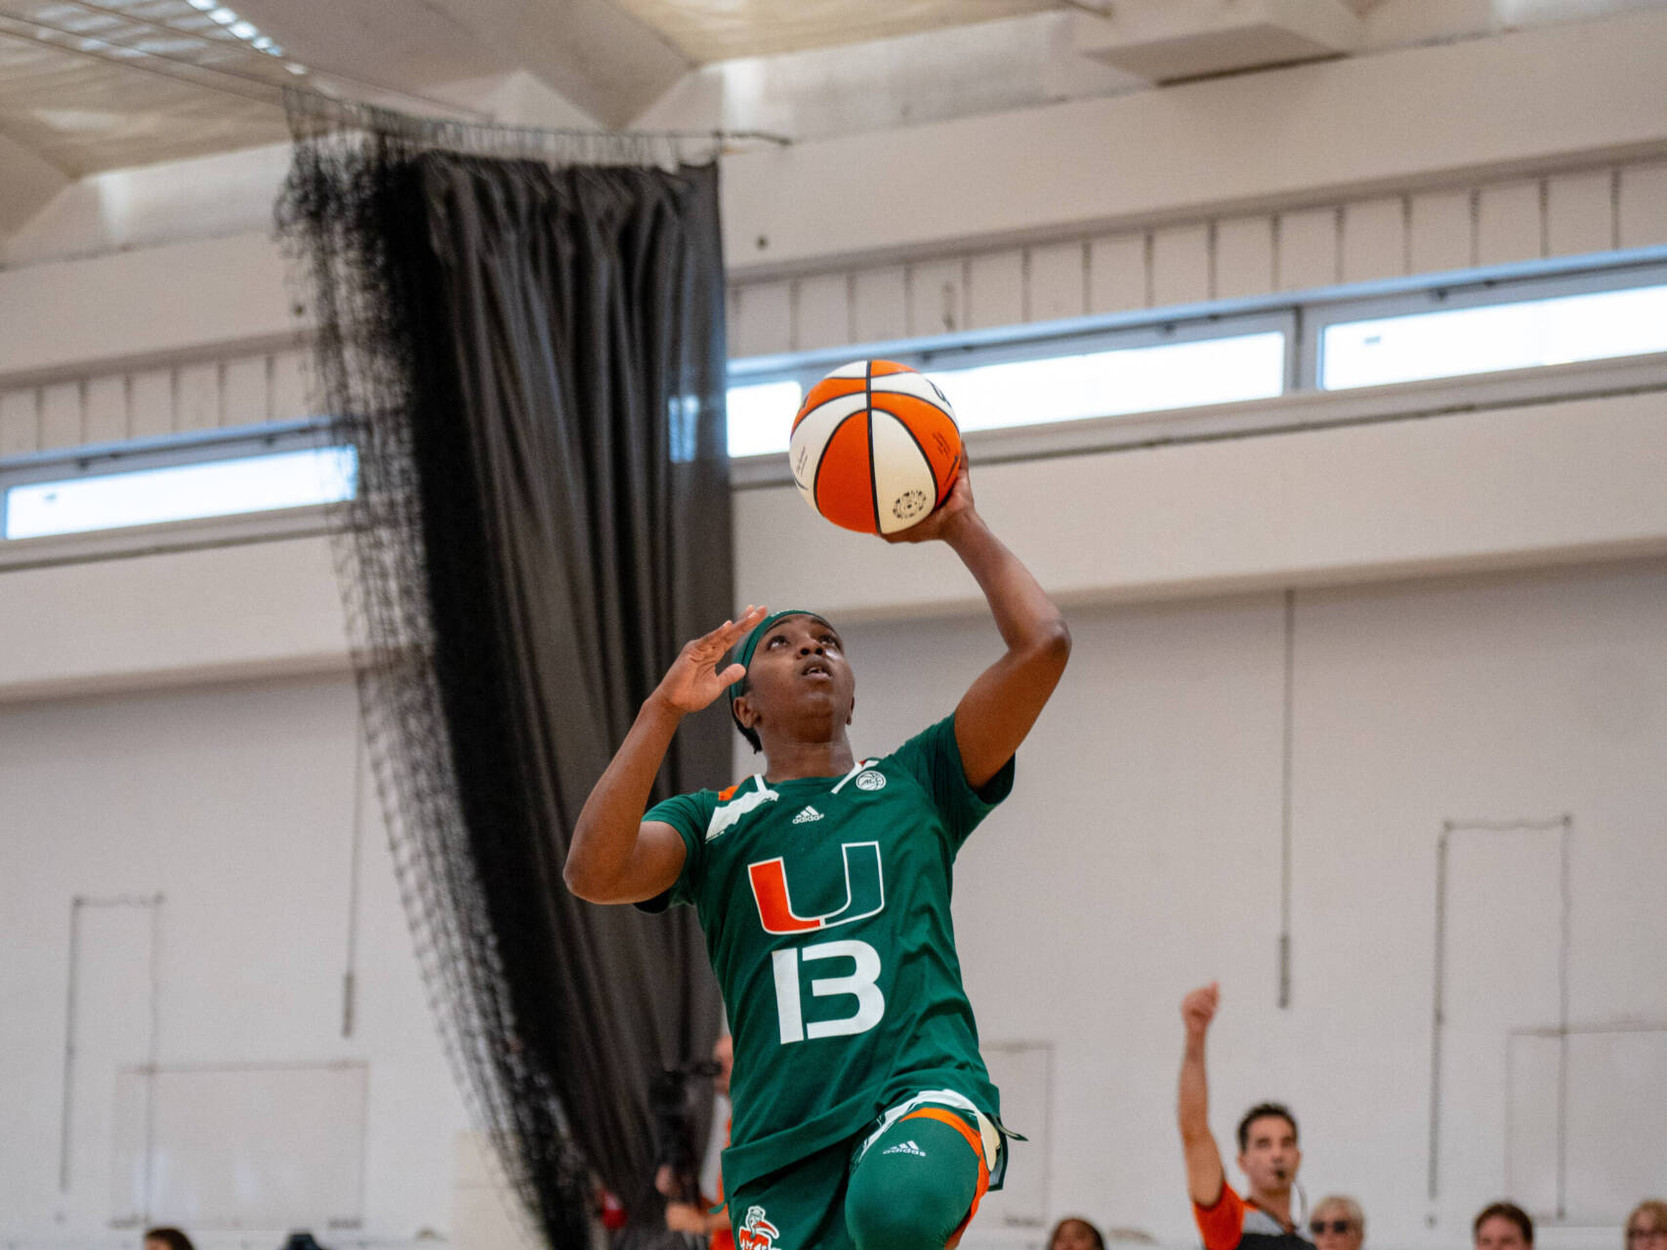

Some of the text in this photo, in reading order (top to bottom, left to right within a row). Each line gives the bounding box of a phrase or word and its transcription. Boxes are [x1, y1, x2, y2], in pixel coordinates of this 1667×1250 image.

[792, 813, 825, 824] adidas
[747, 841, 885, 935] U
[771, 939, 885, 1045] 13
[882, 1147, 926, 1157] adidas
